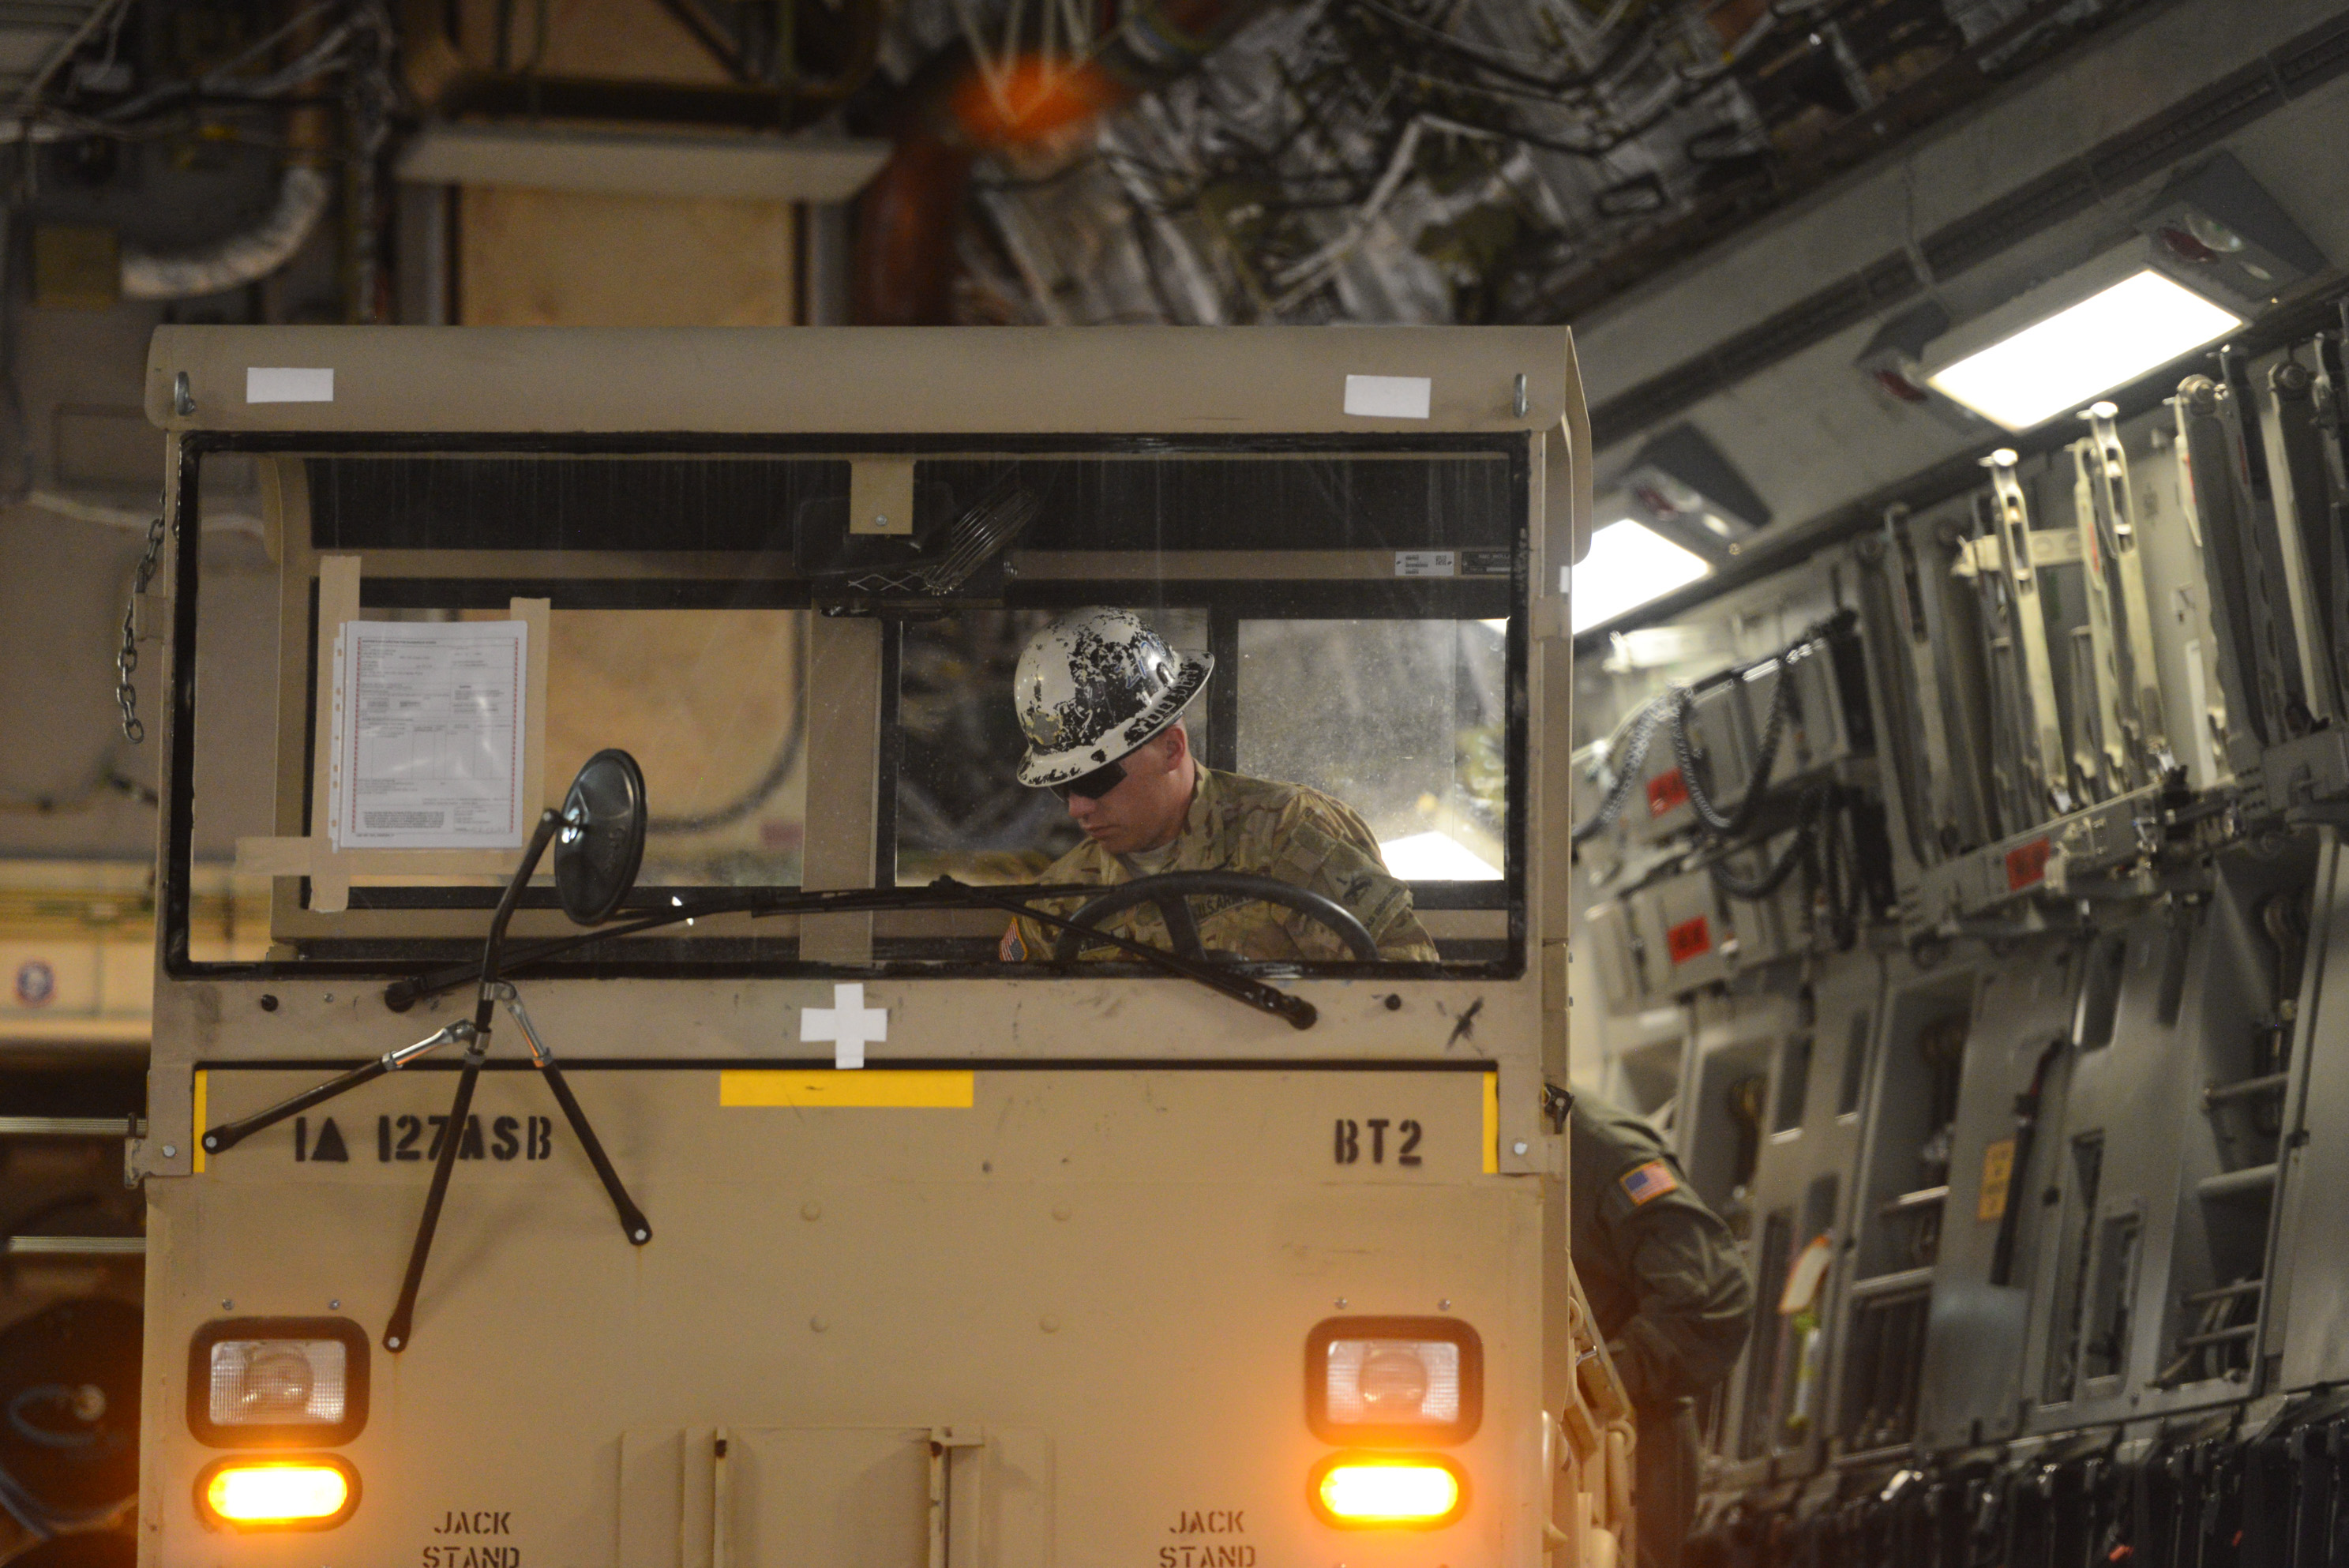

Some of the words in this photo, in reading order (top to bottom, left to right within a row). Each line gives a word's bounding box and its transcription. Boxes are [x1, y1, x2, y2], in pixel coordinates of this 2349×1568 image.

[1334, 1119, 1422, 1166] BT2
[433, 1511, 511, 1535] JACK
[1169, 1510, 1244, 1533] JACK
[422, 1546, 520, 1568] STAND
[1160, 1545, 1256, 1568] STAND
